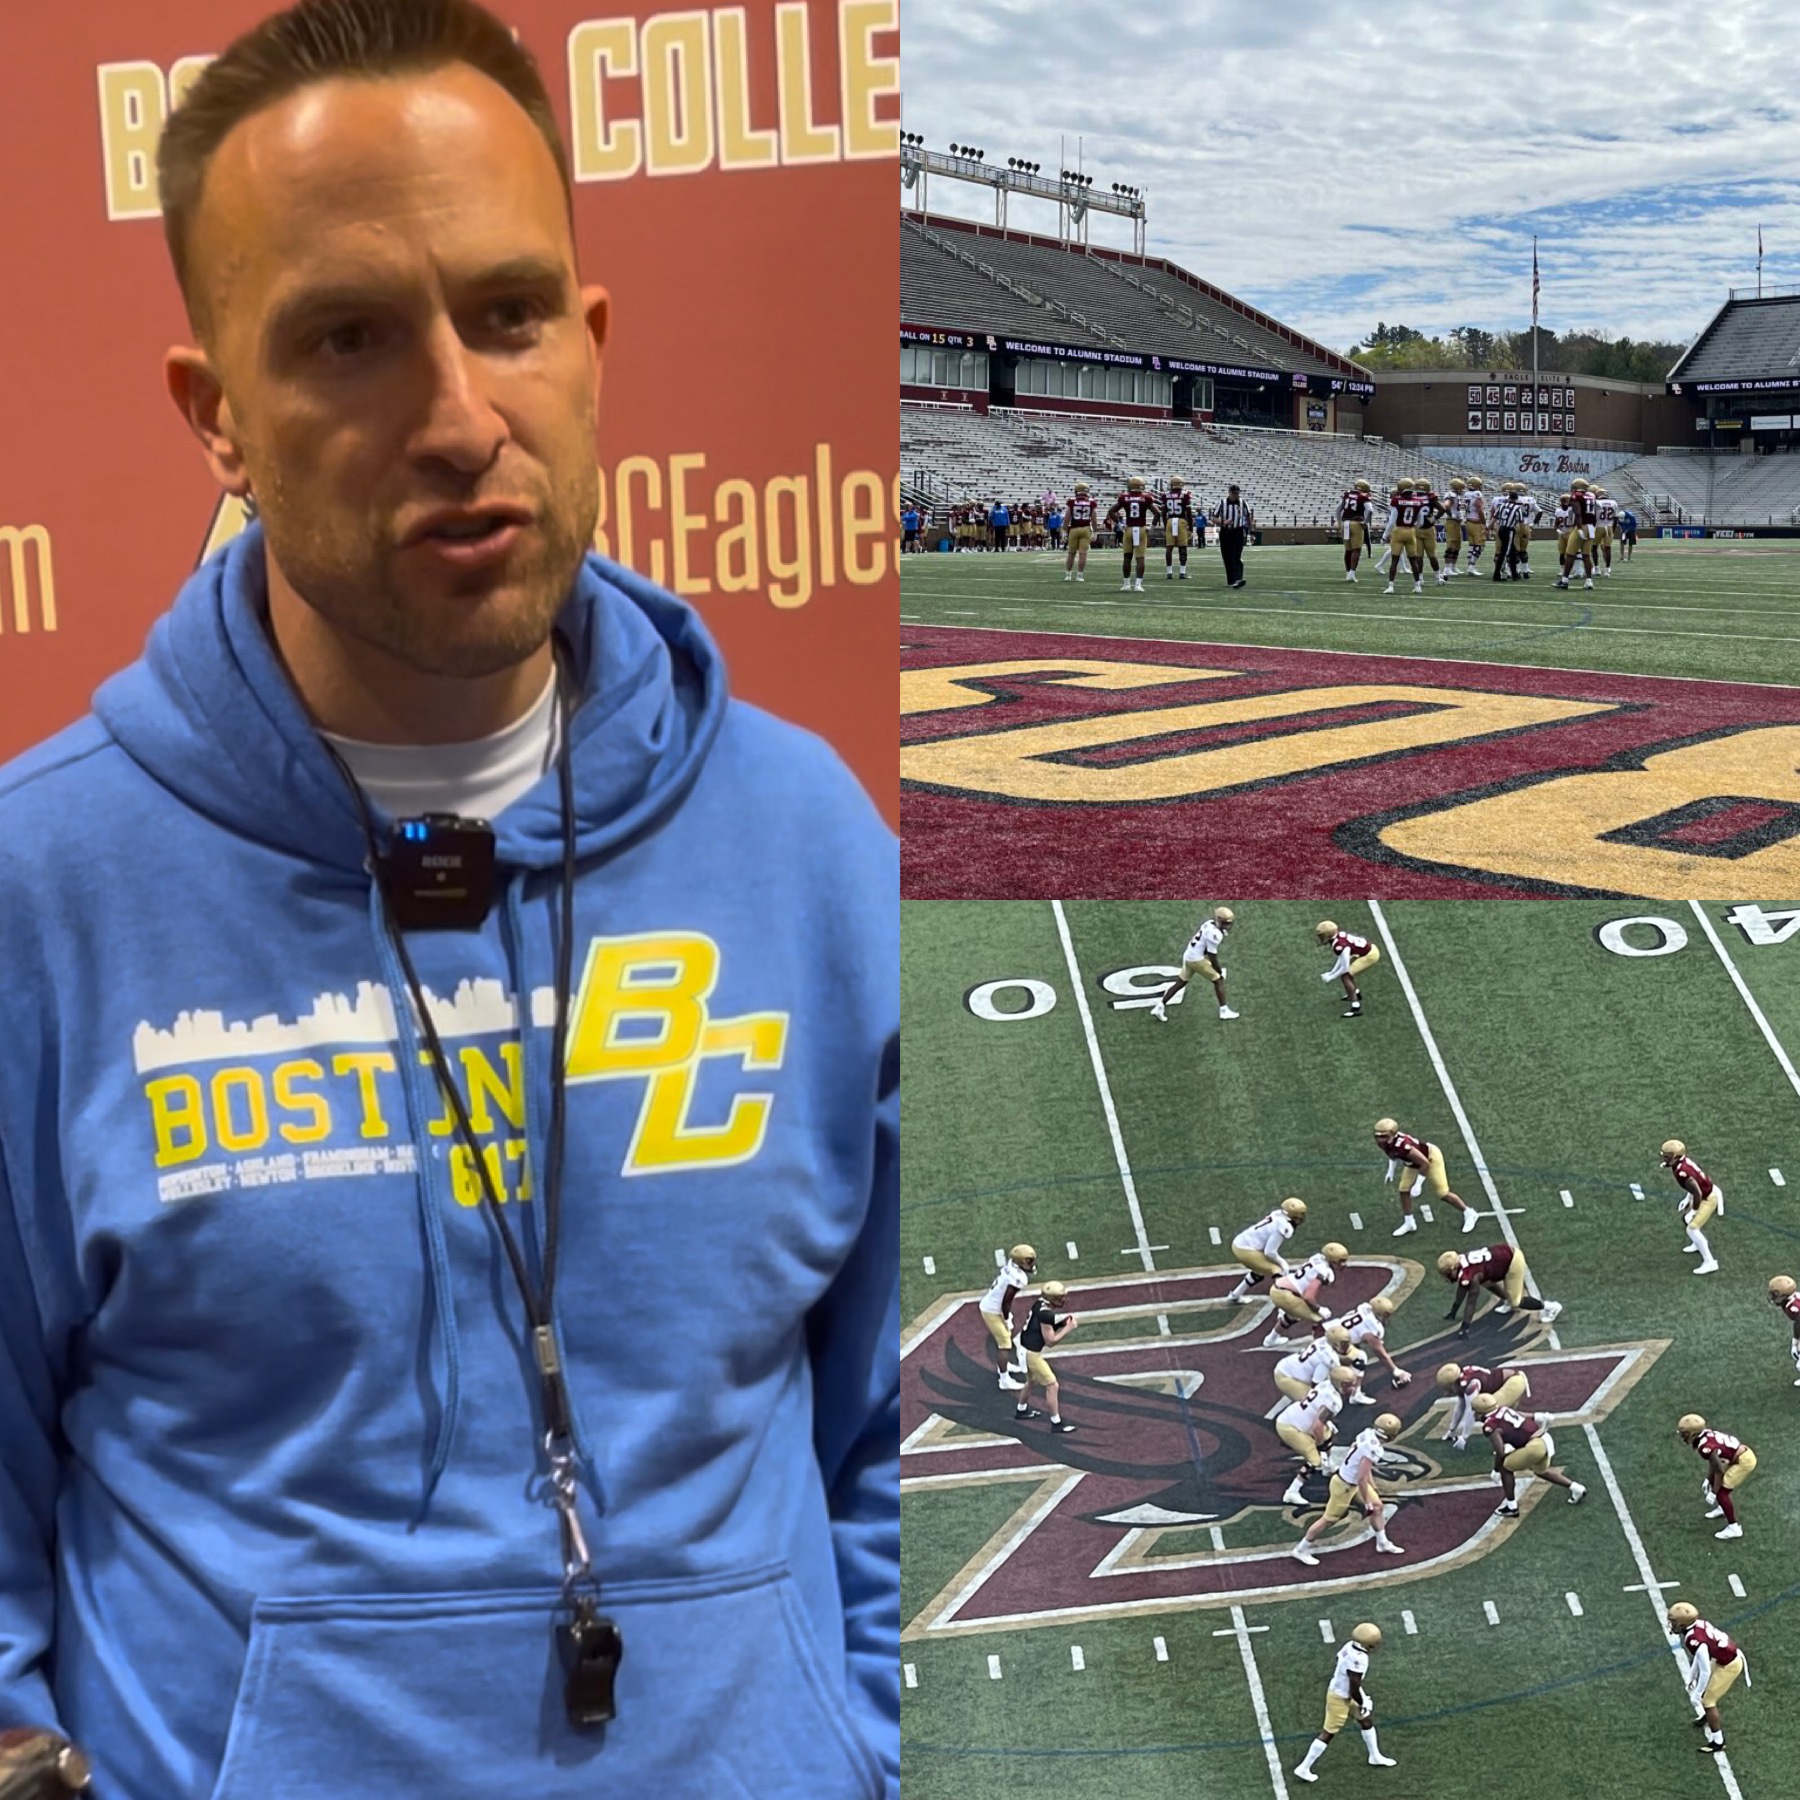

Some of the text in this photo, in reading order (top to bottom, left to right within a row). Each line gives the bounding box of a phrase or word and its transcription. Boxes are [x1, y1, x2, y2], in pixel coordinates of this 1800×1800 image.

[920, 333, 930, 341] ON
[932, 333, 945, 344] 15
[948, 336, 962, 344] QTR
[967, 337, 974, 347] 3
[1006, 341, 1142, 364] WELCOME TO ALUMNI STADIUM
[1169, 361, 1279, 380] WELCOME TO ALUMNI STADIUM
[1697, 383, 1739, 391] WELCOME
[1754, 381, 1790, 389] ALUMNI
[1521, 392, 1533, 404] 22
[1519, 454, 1590, 474] For Boston
[1073, 505, 1091, 520] 52
[1130, 502, 1140, 518] 8
[1166, 498, 1182, 515] 95
[1403, 507, 1414, 524] 0
[595, 443, 900, 609] CEagle
[563, 930, 790, 1179] BC
